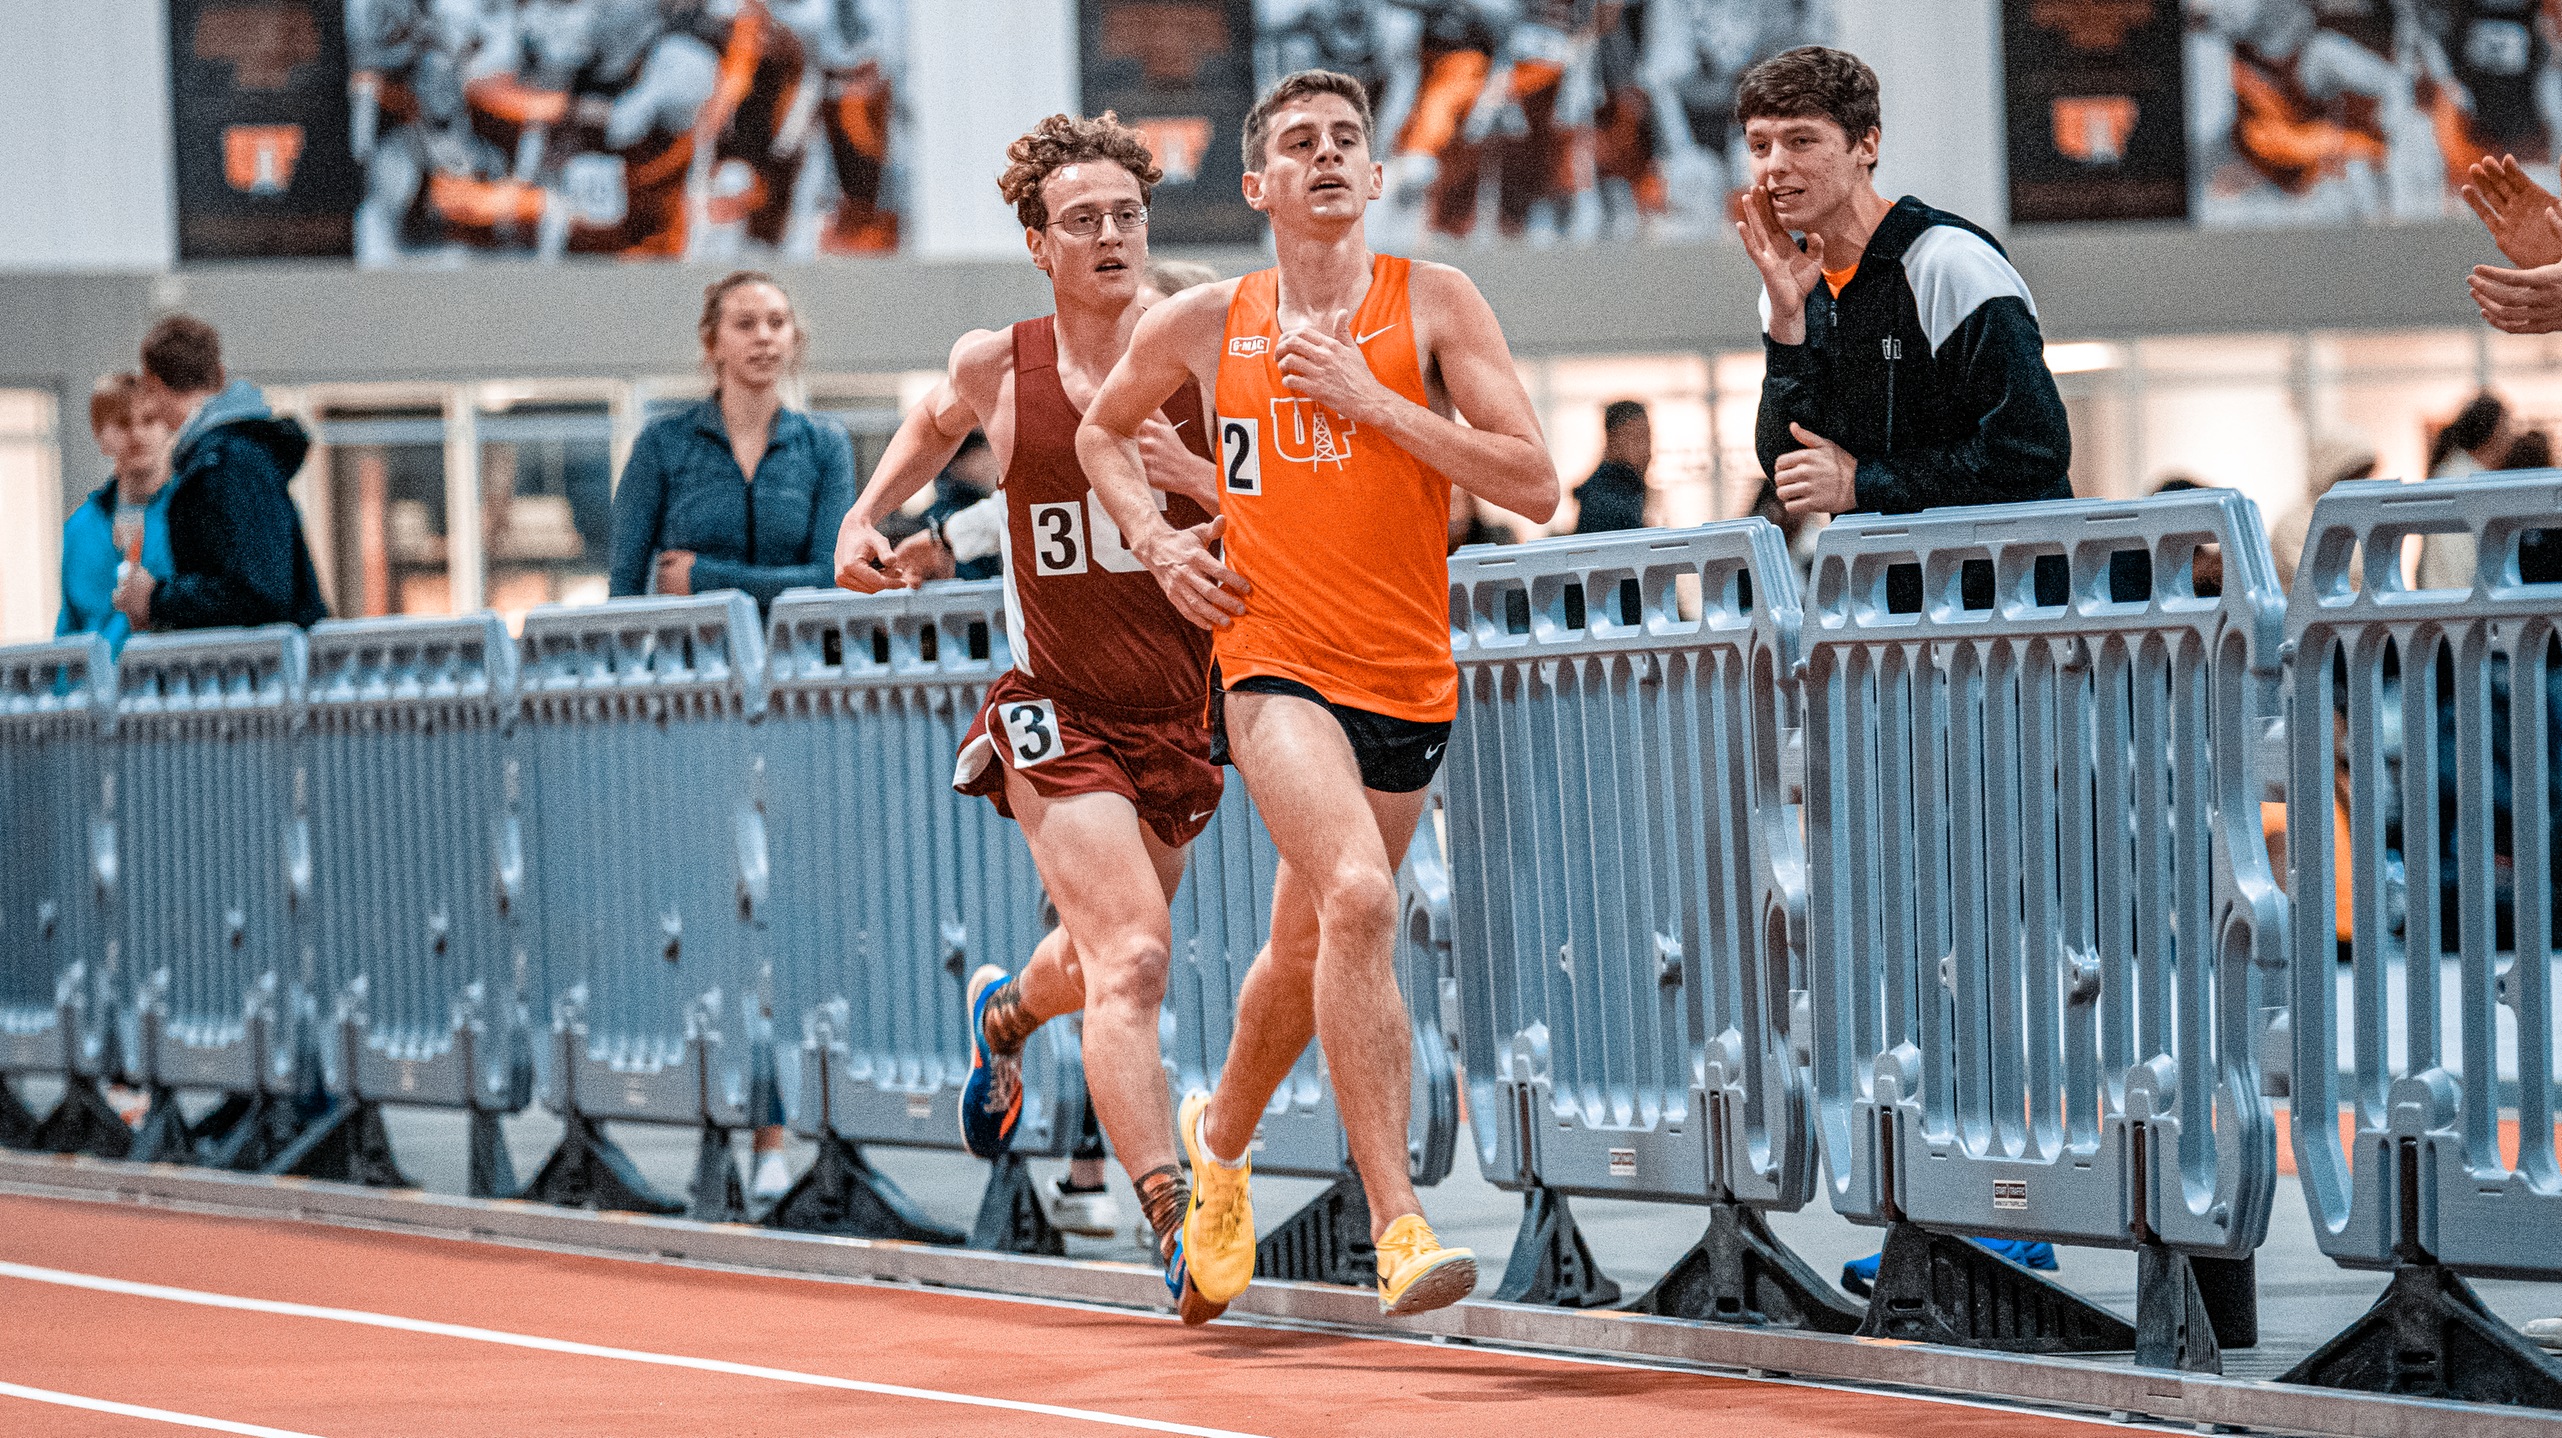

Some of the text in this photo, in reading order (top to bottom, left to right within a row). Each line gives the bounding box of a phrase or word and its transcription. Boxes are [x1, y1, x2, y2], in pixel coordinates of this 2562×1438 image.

[1224, 422, 1254, 490] 2
[1038, 507, 1077, 570] 3
[1010, 704, 1052, 761] 3
